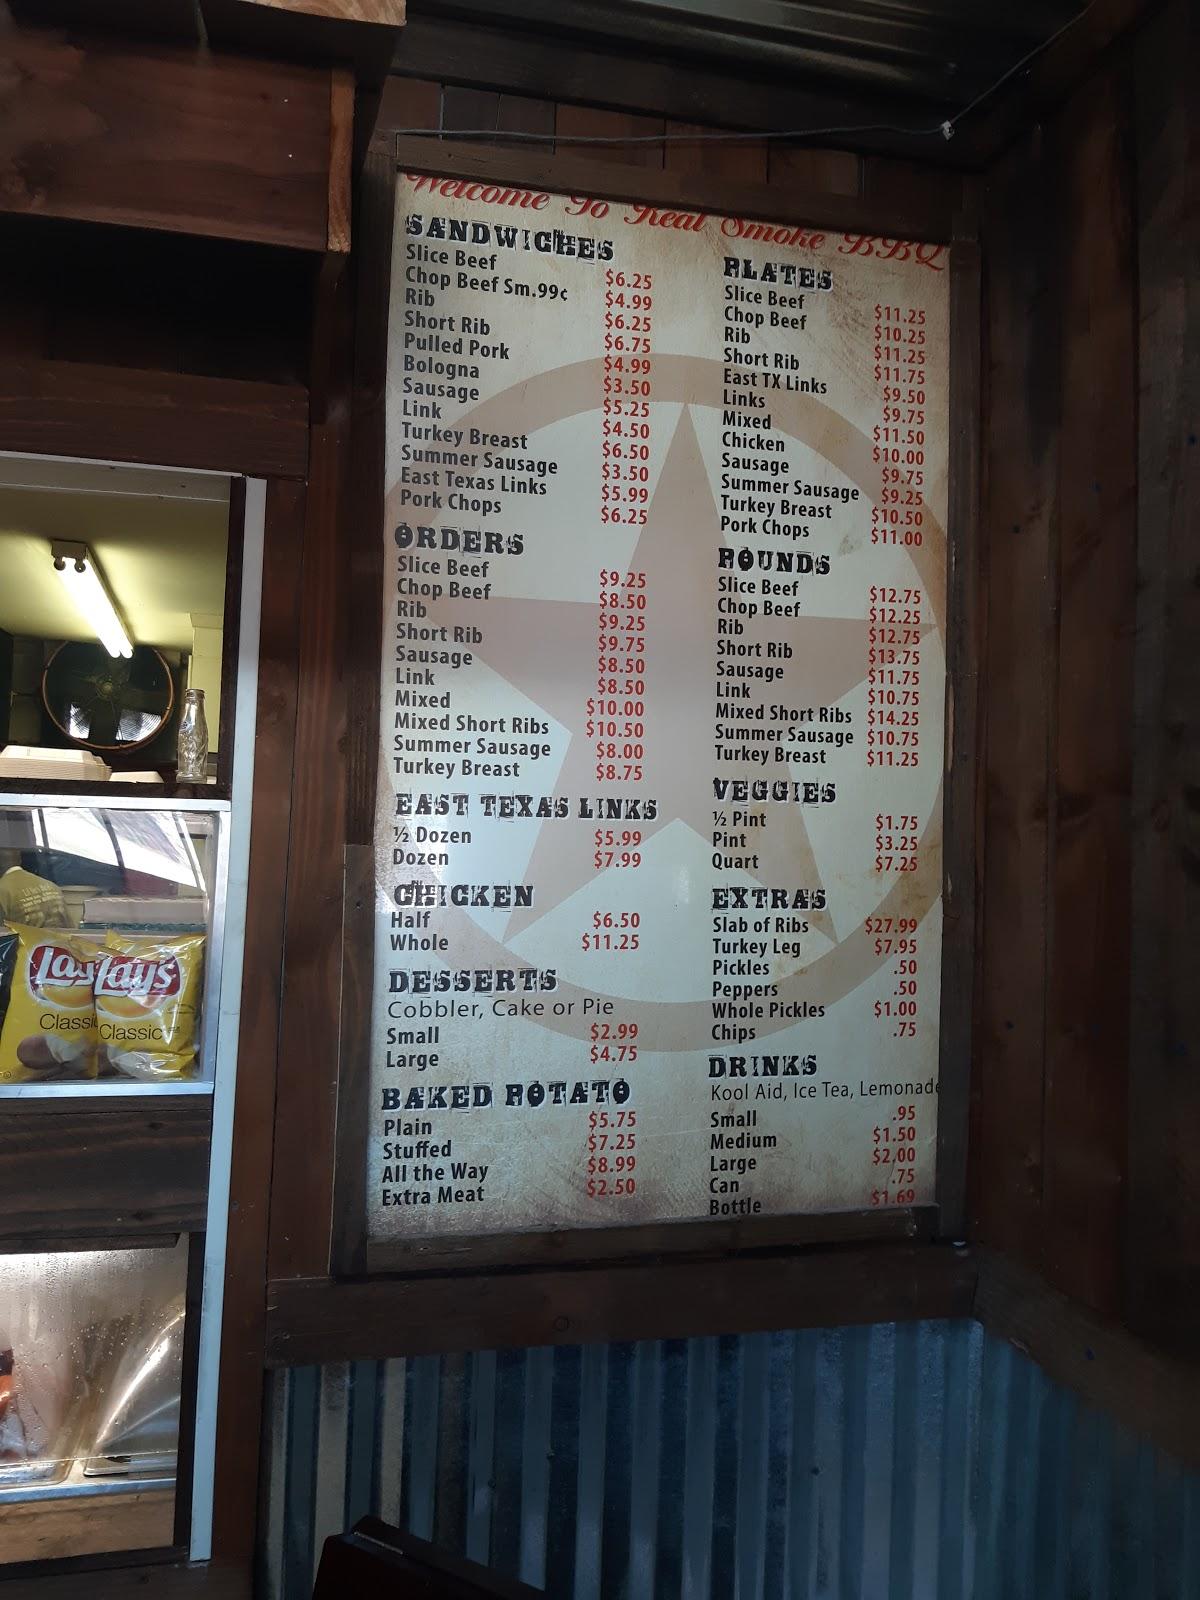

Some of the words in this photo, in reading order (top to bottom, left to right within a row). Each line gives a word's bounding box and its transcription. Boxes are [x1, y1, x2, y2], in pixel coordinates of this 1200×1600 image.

[407, 174, 549, 210] Welcome
[565, 194, 609, 218] To
[624, 203, 706, 232] Real
[720, 217, 824, 249] Smoke
[838, 232, 945, 271] BBQ
[406, 214, 613, 262] SANDWICHES
[407, 244, 448, 264] Slice
[456, 250, 497, 270] Beef
[606, 268, 651, 290] $6.25
[724, 256, 831, 290] PLATES
[406, 266, 450, 292] Chop
[458, 272, 499, 292] Beef
[504, 278, 567, 301] Sm.99¢
[406, 288, 434, 306] Rib
[725, 285, 762, 304] Slice
[768, 290, 804, 309] Beef
[405, 310, 455, 331] Short
[462, 317, 490, 335] Rib
[605, 311, 651, 332] $6.25
[725, 306, 764, 328] Chop
[770, 311, 807, 330] Beef
[875, 304, 925, 325] $11.25
[405, 332, 462, 354] Pulled
[470, 340, 509, 359] Pork
[874, 344, 925, 364] $11.25
[404, 355, 479, 380] Bologna
[604, 354, 650, 374] $4.99
[724, 347, 768, 367] Short
[774, 353, 799, 370] Rib
[403, 377, 479, 404] Sausage
[724, 368, 757, 386] East
[762, 372, 780, 389] TX
[787, 375, 826, 394] Links
[724, 389, 765, 408] Links
[884, 385, 925, 404] $9.50
[403, 399, 441, 419] Link
[604, 397, 649, 417] $5.25
[723, 410, 771, 430] Mixed
[402, 422, 463, 447] Turkey
[470, 428, 528, 450] Breast
[722, 432, 784, 452] Chicken
[874, 425, 924, 445] $11.50
[603, 440, 649, 460] $6.50
[402, 444, 478, 467] Summer
[484, 452, 557, 477] Sausage
[722, 452, 789, 476] Sausage
[402, 466, 440, 486] East
[445, 470, 494, 490] Texas
[502, 476, 546, 495] Links
[882, 466, 923, 485] $9.75
[401, 489, 442, 508] Pork
[448, 494, 501, 516] Chops
[602, 484, 648, 503] $5.99
[721, 494, 775, 518] Turkey
[781, 500, 832, 518] Breast
[872, 506, 922, 526] $10.50
[395, 524, 524, 556] ORDERS
[398, 555, 440, 574] Slice
[448, 559, 489, 578] Beef
[718, 547, 830, 575] POUNDS
[600, 569, 646, 588] $9.25
[718, 576, 756, 594] Slice
[762, 579, 799, 596] Beef
[398, 578, 442, 600] Chop
[450, 582, 491, 600] Beef
[870, 586, 920, 604] $12.75
[398, 600, 426, 618] Rib
[718, 598, 757, 618] Chop
[764, 600, 800, 617] Beef
[600, 612, 645, 631] $9.25
[870, 626, 920, 644] $12.75
[717, 640, 762, 657] Short
[768, 642, 792, 658] Rib
[598, 655, 644, 674] $8.50
[717, 661, 783, 682] Sausage
[396, 668, 435, 685] Link
[869, 667, 919, 685] $11.75
[587, 698, 644, 716] $10.00
[868, 708, 918, 726] $14.25
[395, 712, 450, 730] Mixed
[456, 715, 506, 732] Short
[512, 717, 548, 734] Ribs
[716, 724, 783, 741] Summer
[788, 726, 853, 747] Sausage
[394, 735, 471, 753] Summer
[477, 738, 550, 760] Sausage
[597, 741, 643, 760] $8.00
[394, 757, 455, 779] Turkey
[462, 759, 520, 777] Breast
[868, 749, 918, 767] $11.25
[713, 778, 836, 803] VEGGIES
[396, 793, 469, 816] EAST
[480, 794, 568, 818] TEXAS
[578, 798, 656, 820] LINKS
[595, 829, 641, 847] $5.99
[713, 832, 746, 847] Pint
[876, 834, 917, 852] $3.25
[393, 848, 448, 865] Dozen
[712, 853, 758, 870] Quart
[394, 880, 533, 912] CHICKEN
[712, 887, 826, 910] EXTRAS
[392, 911, 430, 928] Half
[594, 911, 640, 929] $6.50
[714, 916, 748, 932] Slab
[754, 917, 770, 932] of
[776, 917, 808, 932] Ribs
[865, 916, 917, 935] $27.99
[390, 934, 448, 950] Whole
[713, 938, 767, 958] Turkey
[774, 938, 800, 958] Leg
[713, 959, 769, 975] Pickles
[894, 960, 917, 974] .50
[389, 968, 556, 994] DESSERTS
[713, 981, 777, 1001] Peppers
[388, 1000, 483, 1019] Cobbler,
[493, 999, 544, 1016] Cake
[553, 1003, 574, 1015] or
[584, 998, 613, 1014] Pie
[875, 1000, 916, 1018] $1.00
[100, 1023, 163, 1040] Classic
[387, 1026, 439, 1044] Small
[591, 1022, 638, 1042] $2.99
[712, 1024, 755, 1044] Chips
[387, 1051, 438, 1071] Large
[708, 1055, 816, 1078] DRINKS
[382, 1084, 492, 1111] BAKED
[505, 1078, 630, 1107] POTATO
[712, 1083, 748, 1100] Kool
[755, 1082, 786, 1101] Aid,
[794, 1082, 816, 1098] Ice
[822, 1082, 853, 1098] Tea,
[589, 1111, 636, 1132] $5.75
[893, 1106, 915, 1120] .95
[385, 1118, 432, 1136] Plain
[383, 1140, 451, 1160] Stuffed
[710, 1132, 776, 1150] Medium
[588, 1156, 635, 1175] $8.99
[711, 1156, 756, 1175] Large
[873, 1147, 915, 1166] $2.00
[382, 1165, 406, 1183] All
[413, 1164, 444, 1181] the
[451, 1162, 488, 1183] Way
[710, 1176, 739, 1193] Can
[382, 1189, 430, 1206] Extra
[438, 1186, 484, 1203] Meat
[709, 1196, 761, 1215] Bottle
